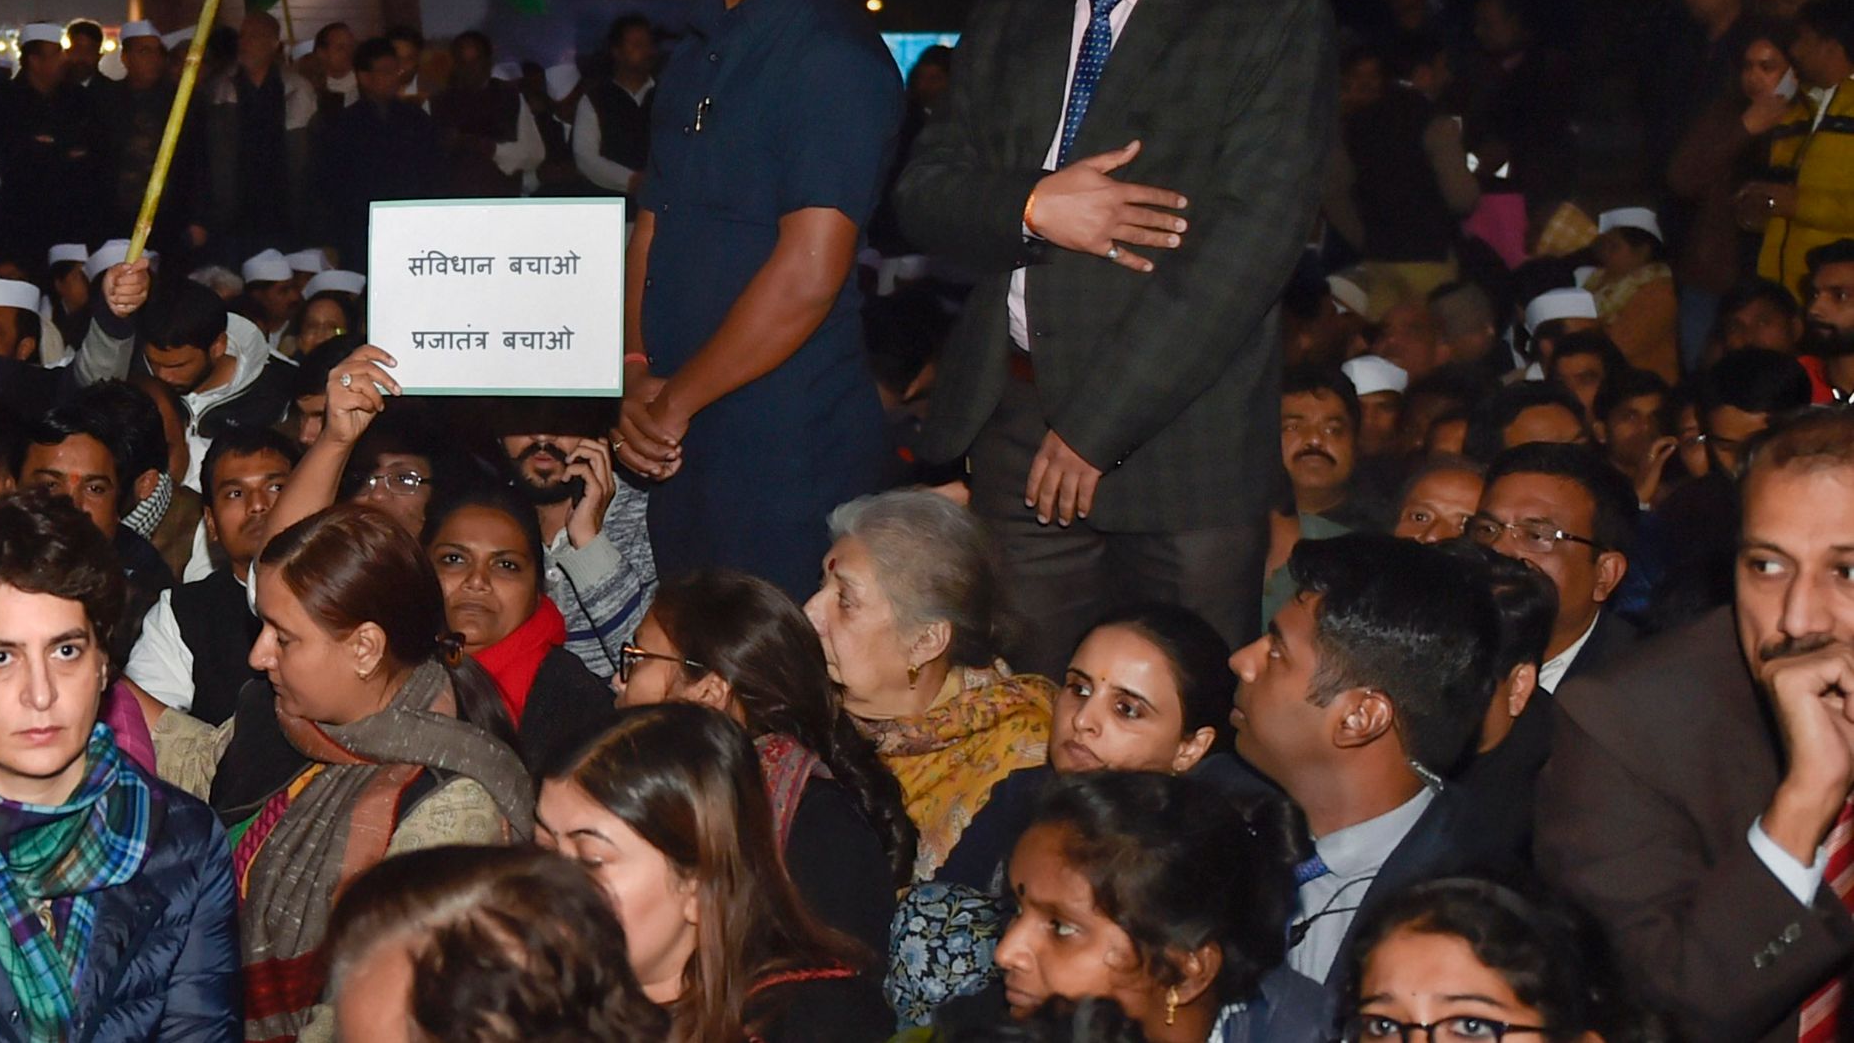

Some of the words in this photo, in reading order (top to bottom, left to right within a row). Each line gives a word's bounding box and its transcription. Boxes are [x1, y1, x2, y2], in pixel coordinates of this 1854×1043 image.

[408, 250, 496, 277] संविधान
[508, 250, 581, 275] बचाओ
[411, 324, 490, 351] प्रजातंत्र
[502, 325, 575, 351] बचाओ
